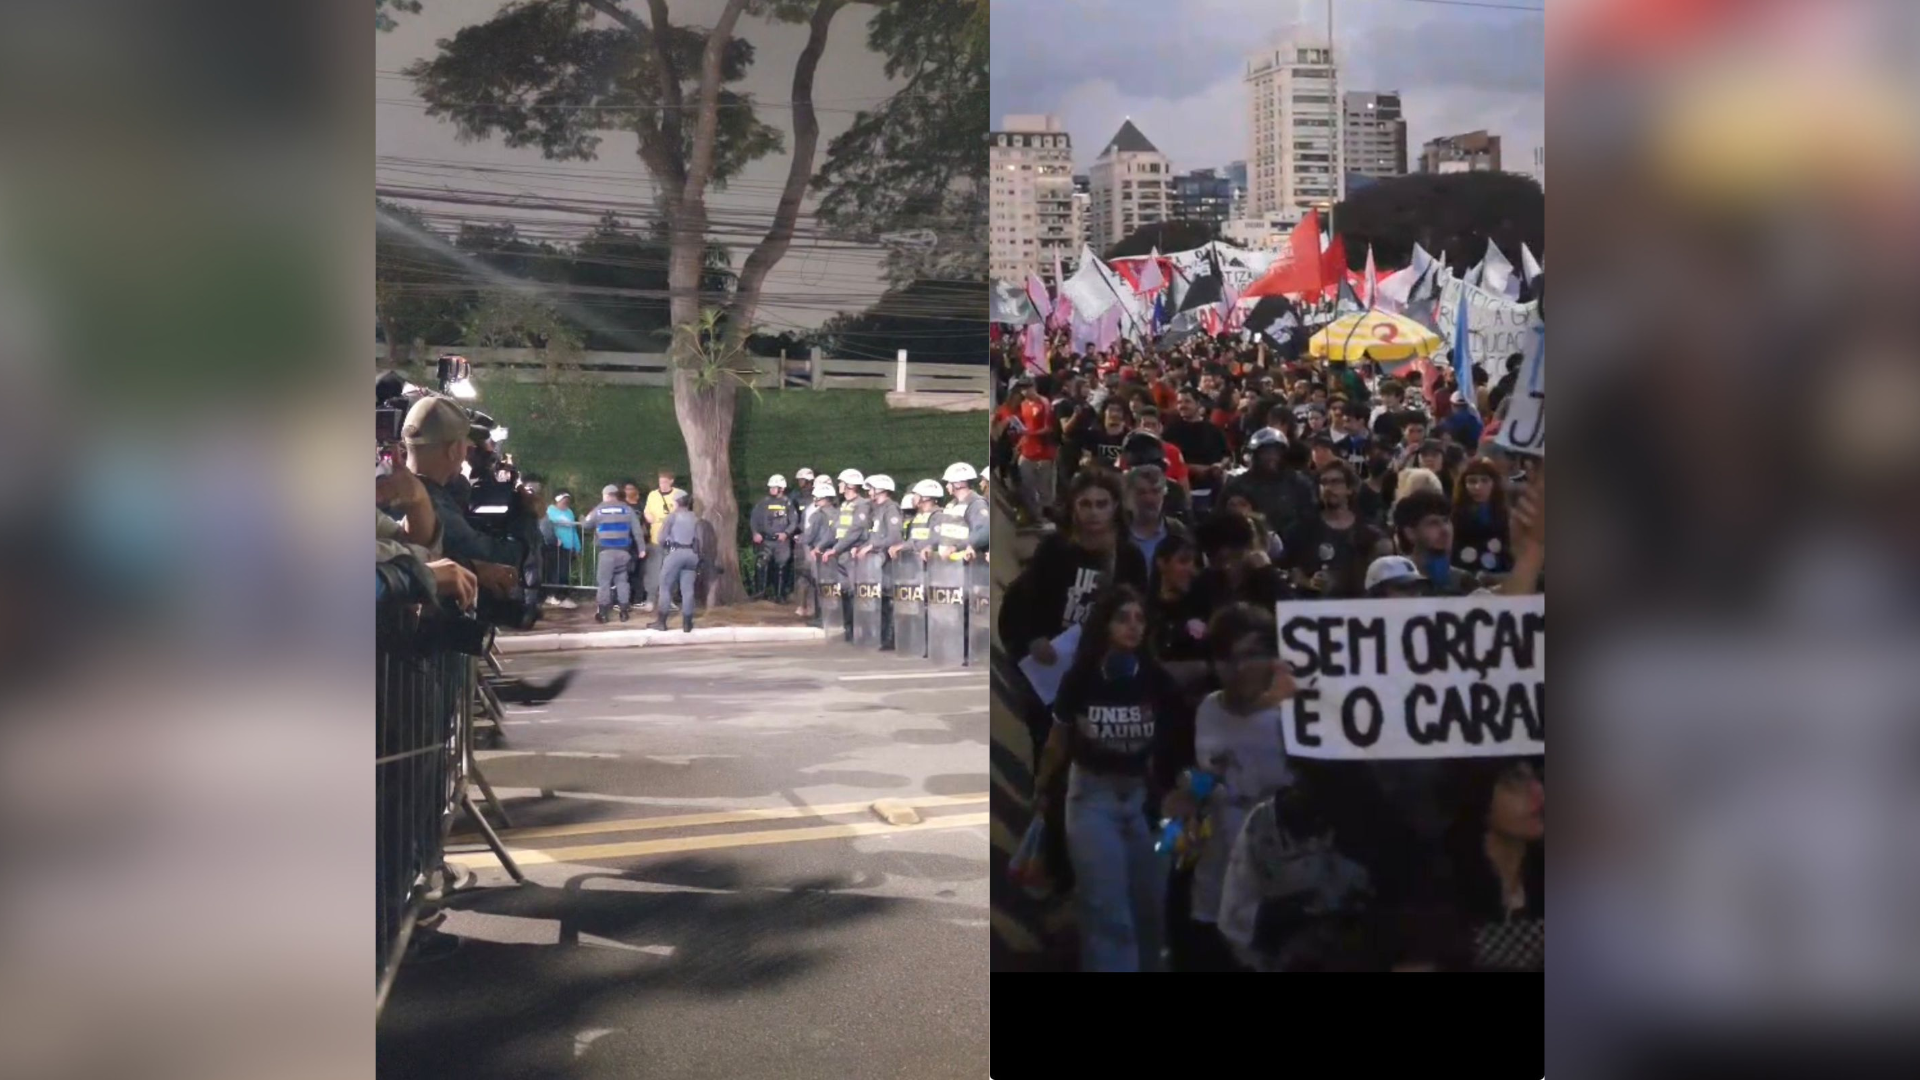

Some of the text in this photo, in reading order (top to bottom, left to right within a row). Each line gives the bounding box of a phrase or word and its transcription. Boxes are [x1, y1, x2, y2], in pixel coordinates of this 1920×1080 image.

[1281, 616, 1387, 678] SEM
[1293, 677, 1322, 747] É
[1342, 686, 1384, 747] O
